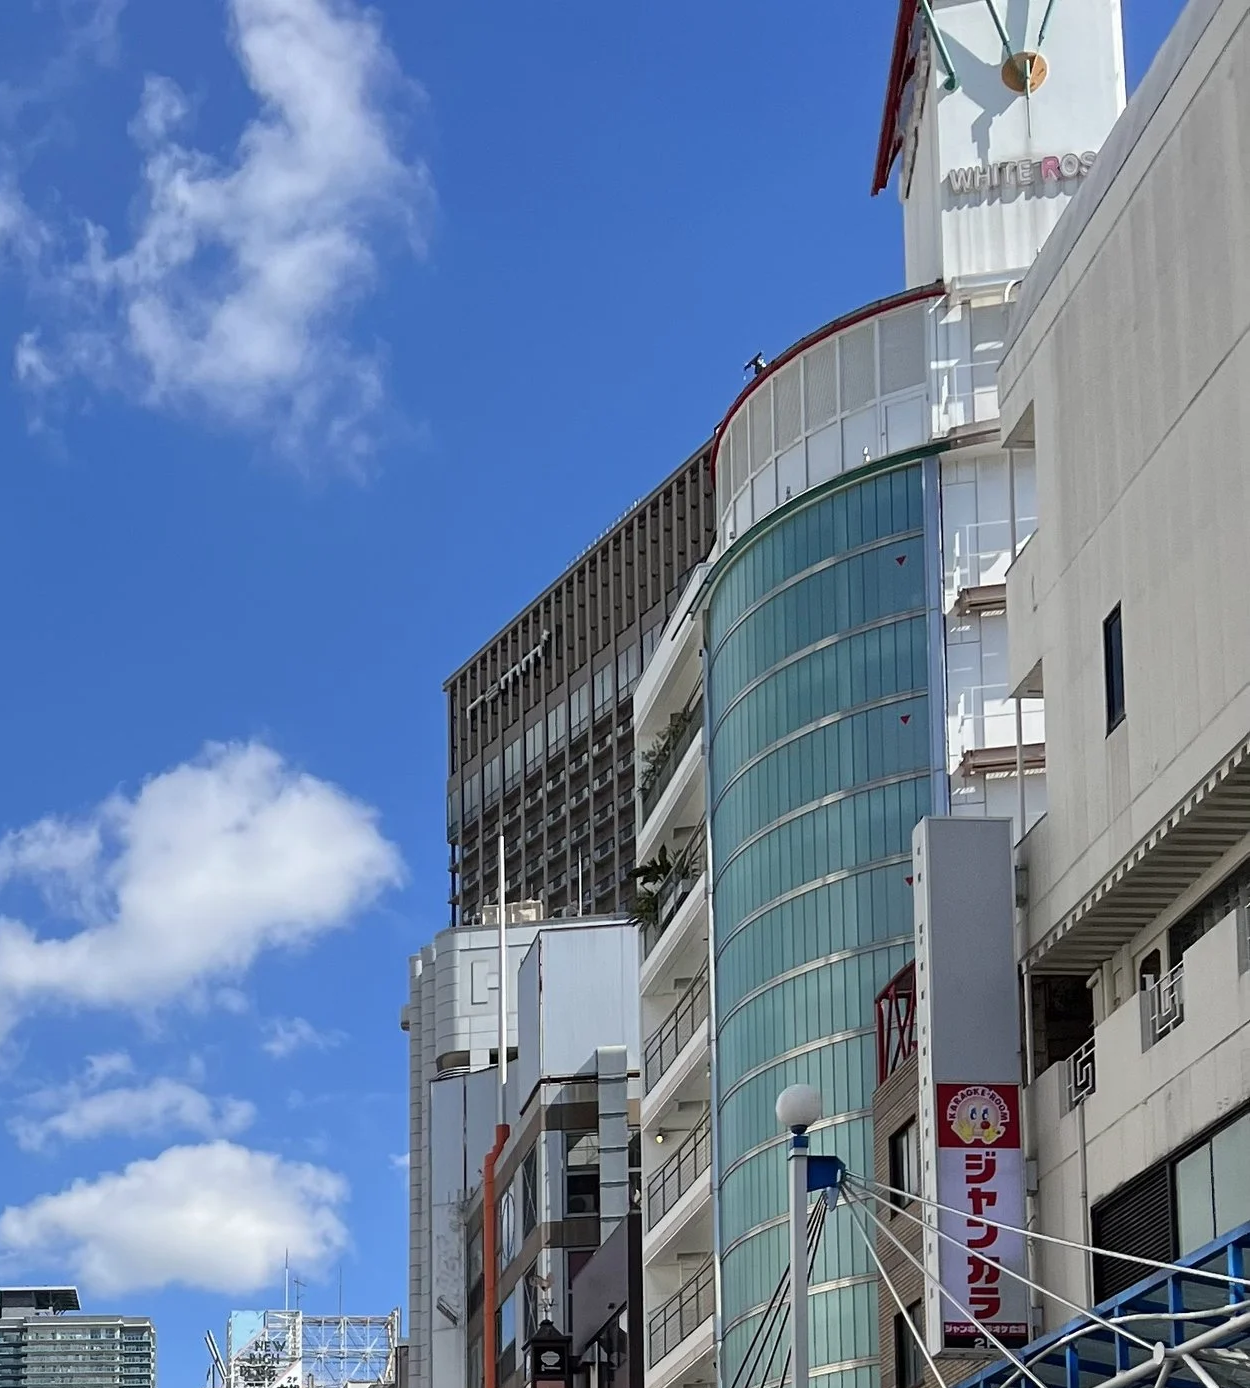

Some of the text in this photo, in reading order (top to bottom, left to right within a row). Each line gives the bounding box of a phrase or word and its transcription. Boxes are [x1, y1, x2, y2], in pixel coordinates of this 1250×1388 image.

[949, 150, 1100, 195] WHITE ROS
[948, 1088, 986, 1120] KARAOKE
[964, 1151, 1002, 1321] ジャンカラ
[254, 1340, 287, 1352] NEW
